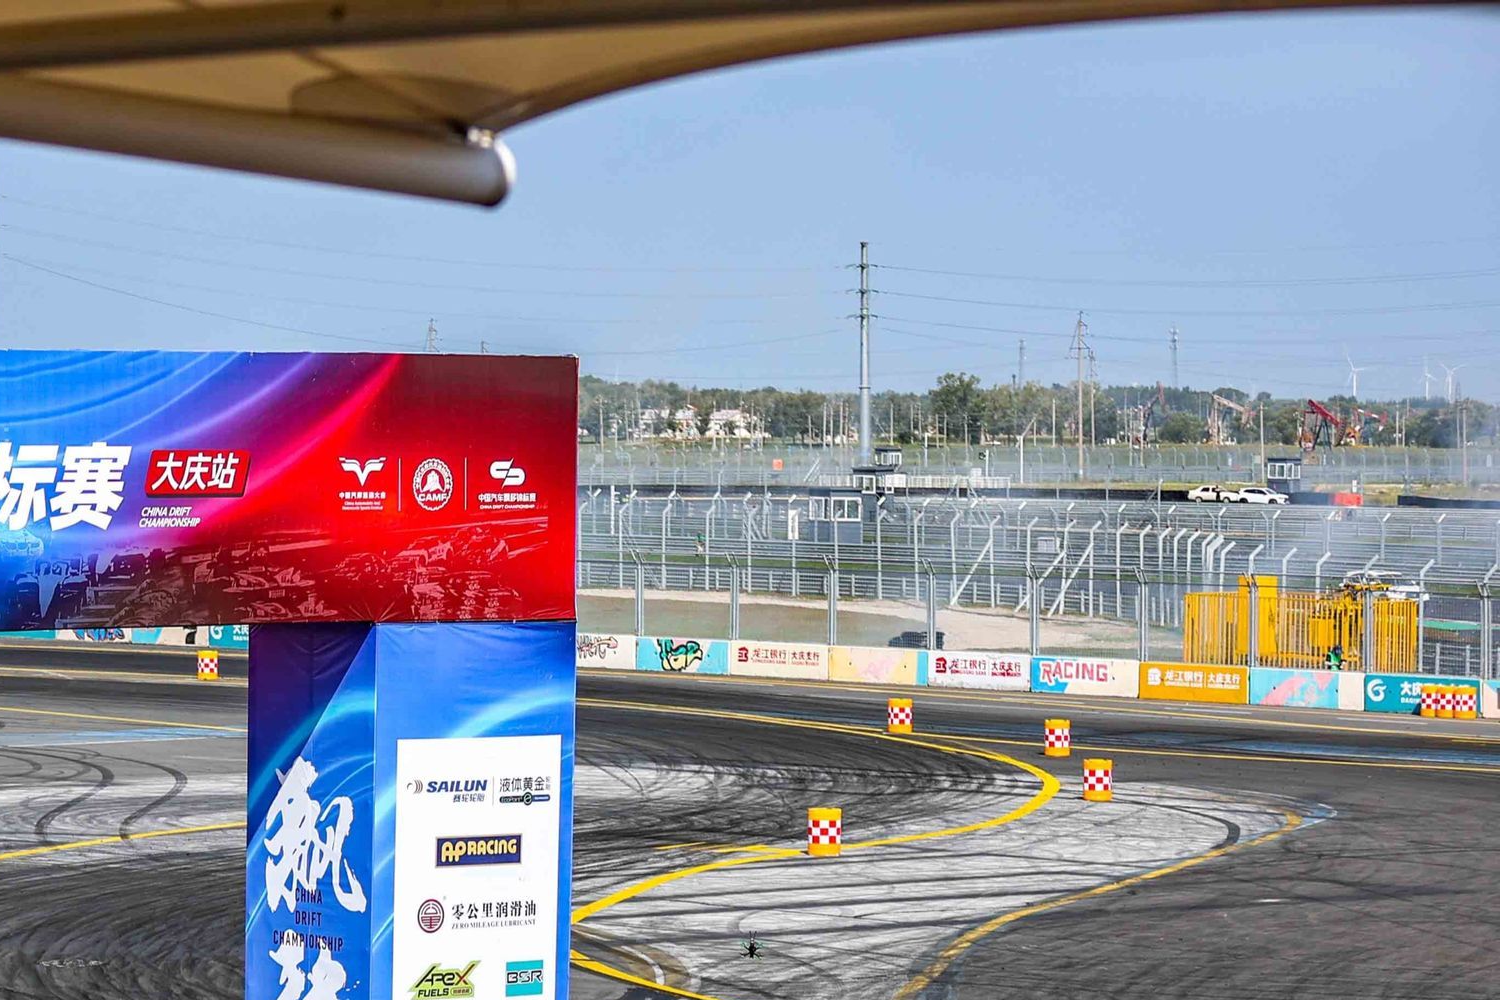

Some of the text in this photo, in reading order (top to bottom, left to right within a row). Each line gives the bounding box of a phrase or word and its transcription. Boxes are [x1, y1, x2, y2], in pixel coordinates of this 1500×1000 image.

[151, 452, 239, 490] 大庆站
[141, 507, 192, 516] CHINA DRIFT
[139, 518, 200, 527] CHAMPIONSHIP
[1041, 661, 1108, 684] RACING
[426, 780, 487, 792] SAILUN
[500, 776, 545, 792] 液体黄金
[467, 839, 517, 855] RACING
[295, 887, 322, 904] CHINA
[451, 900, 536, 919] 零公里润滑油
[295, 911, 321, 926] DRIFT
[273, 930, 343, 951] CHAMPIONSHIP
[507, 970, 543, 983] BSR
[418, 988, 449, 998] FUELS
